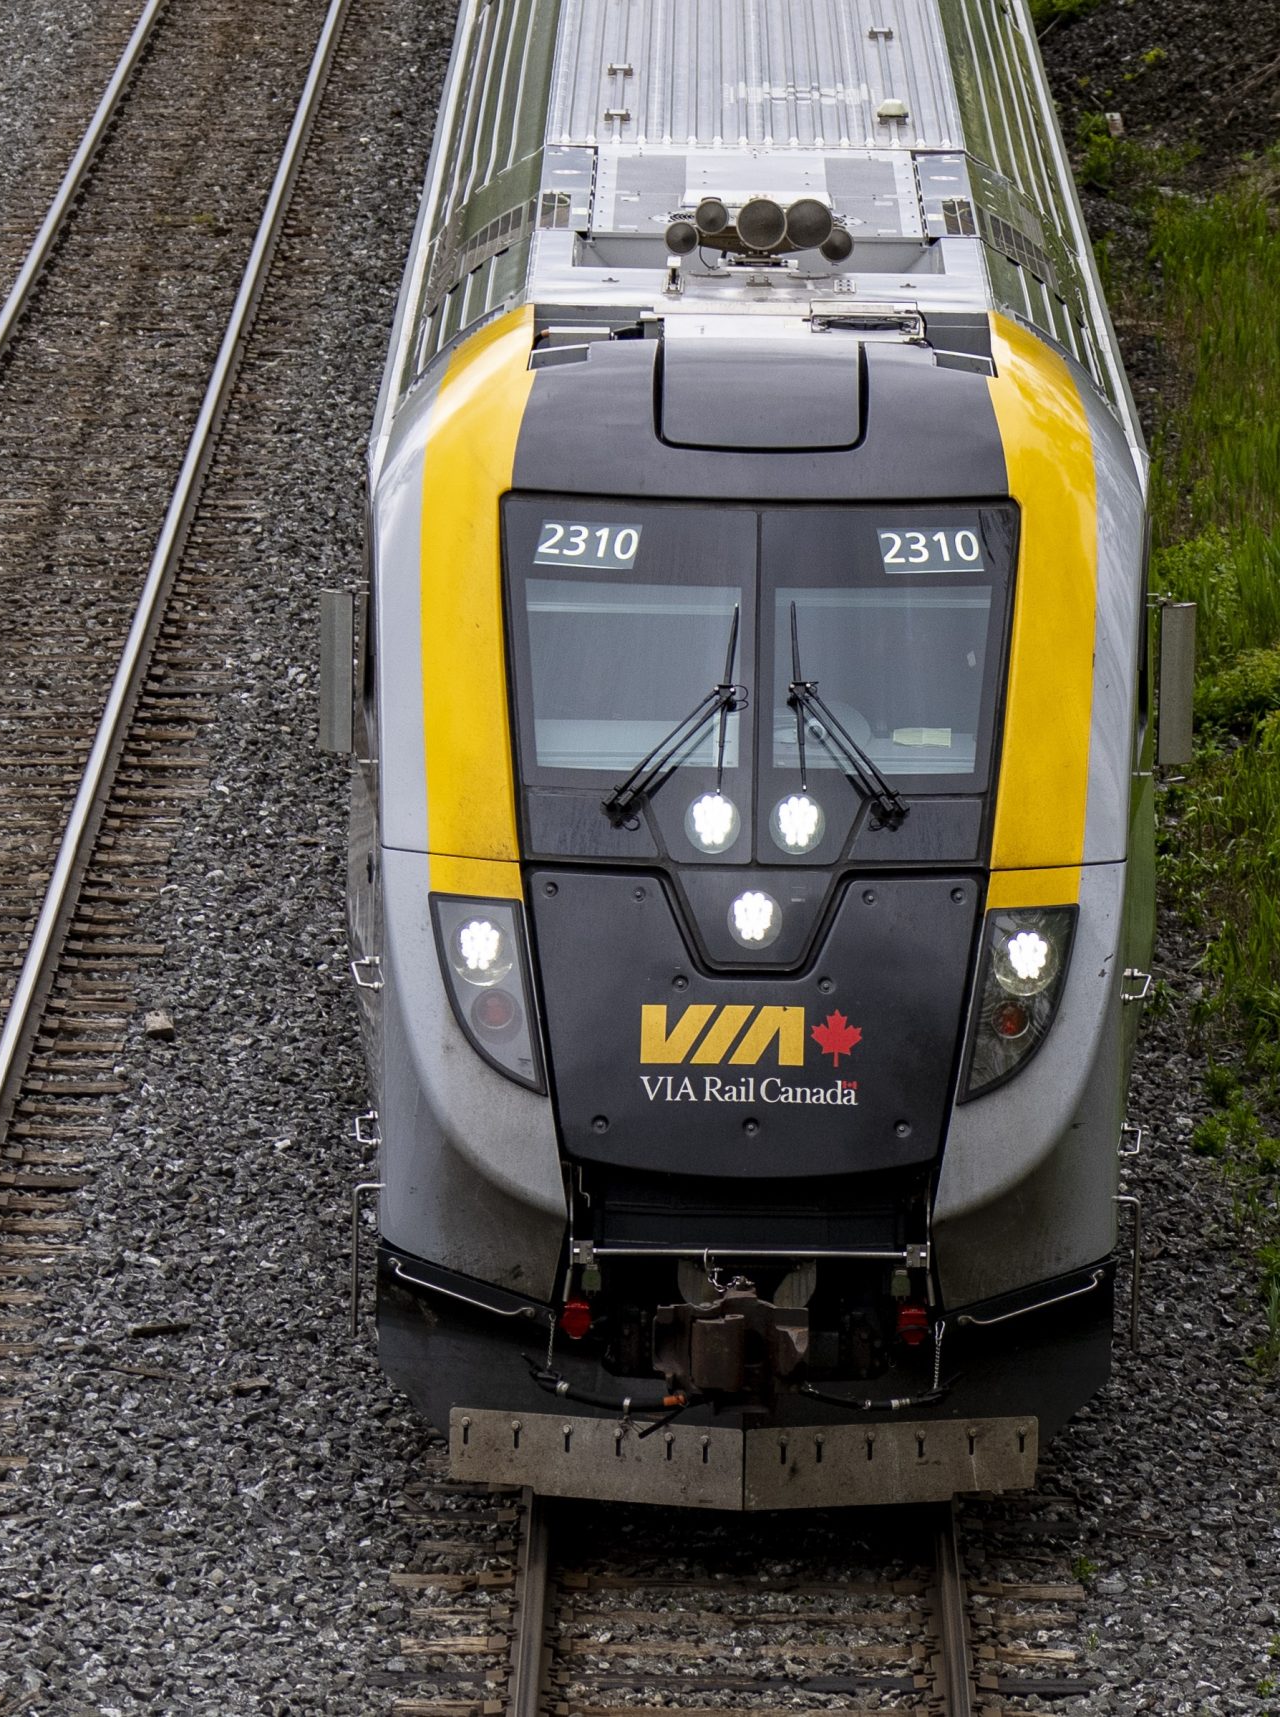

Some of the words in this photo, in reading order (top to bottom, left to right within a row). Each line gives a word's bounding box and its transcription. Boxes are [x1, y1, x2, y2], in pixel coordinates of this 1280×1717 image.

[537, 523, 639, 560] 2310
[880, 530, 980, 563] 2310
[639, 1004, 805, 1066] VIA
[639, 1076, 698, 1101] VIA
[703, 1076, 755, 1102] Rail
[759, 1077, 858, 1106] Canada
